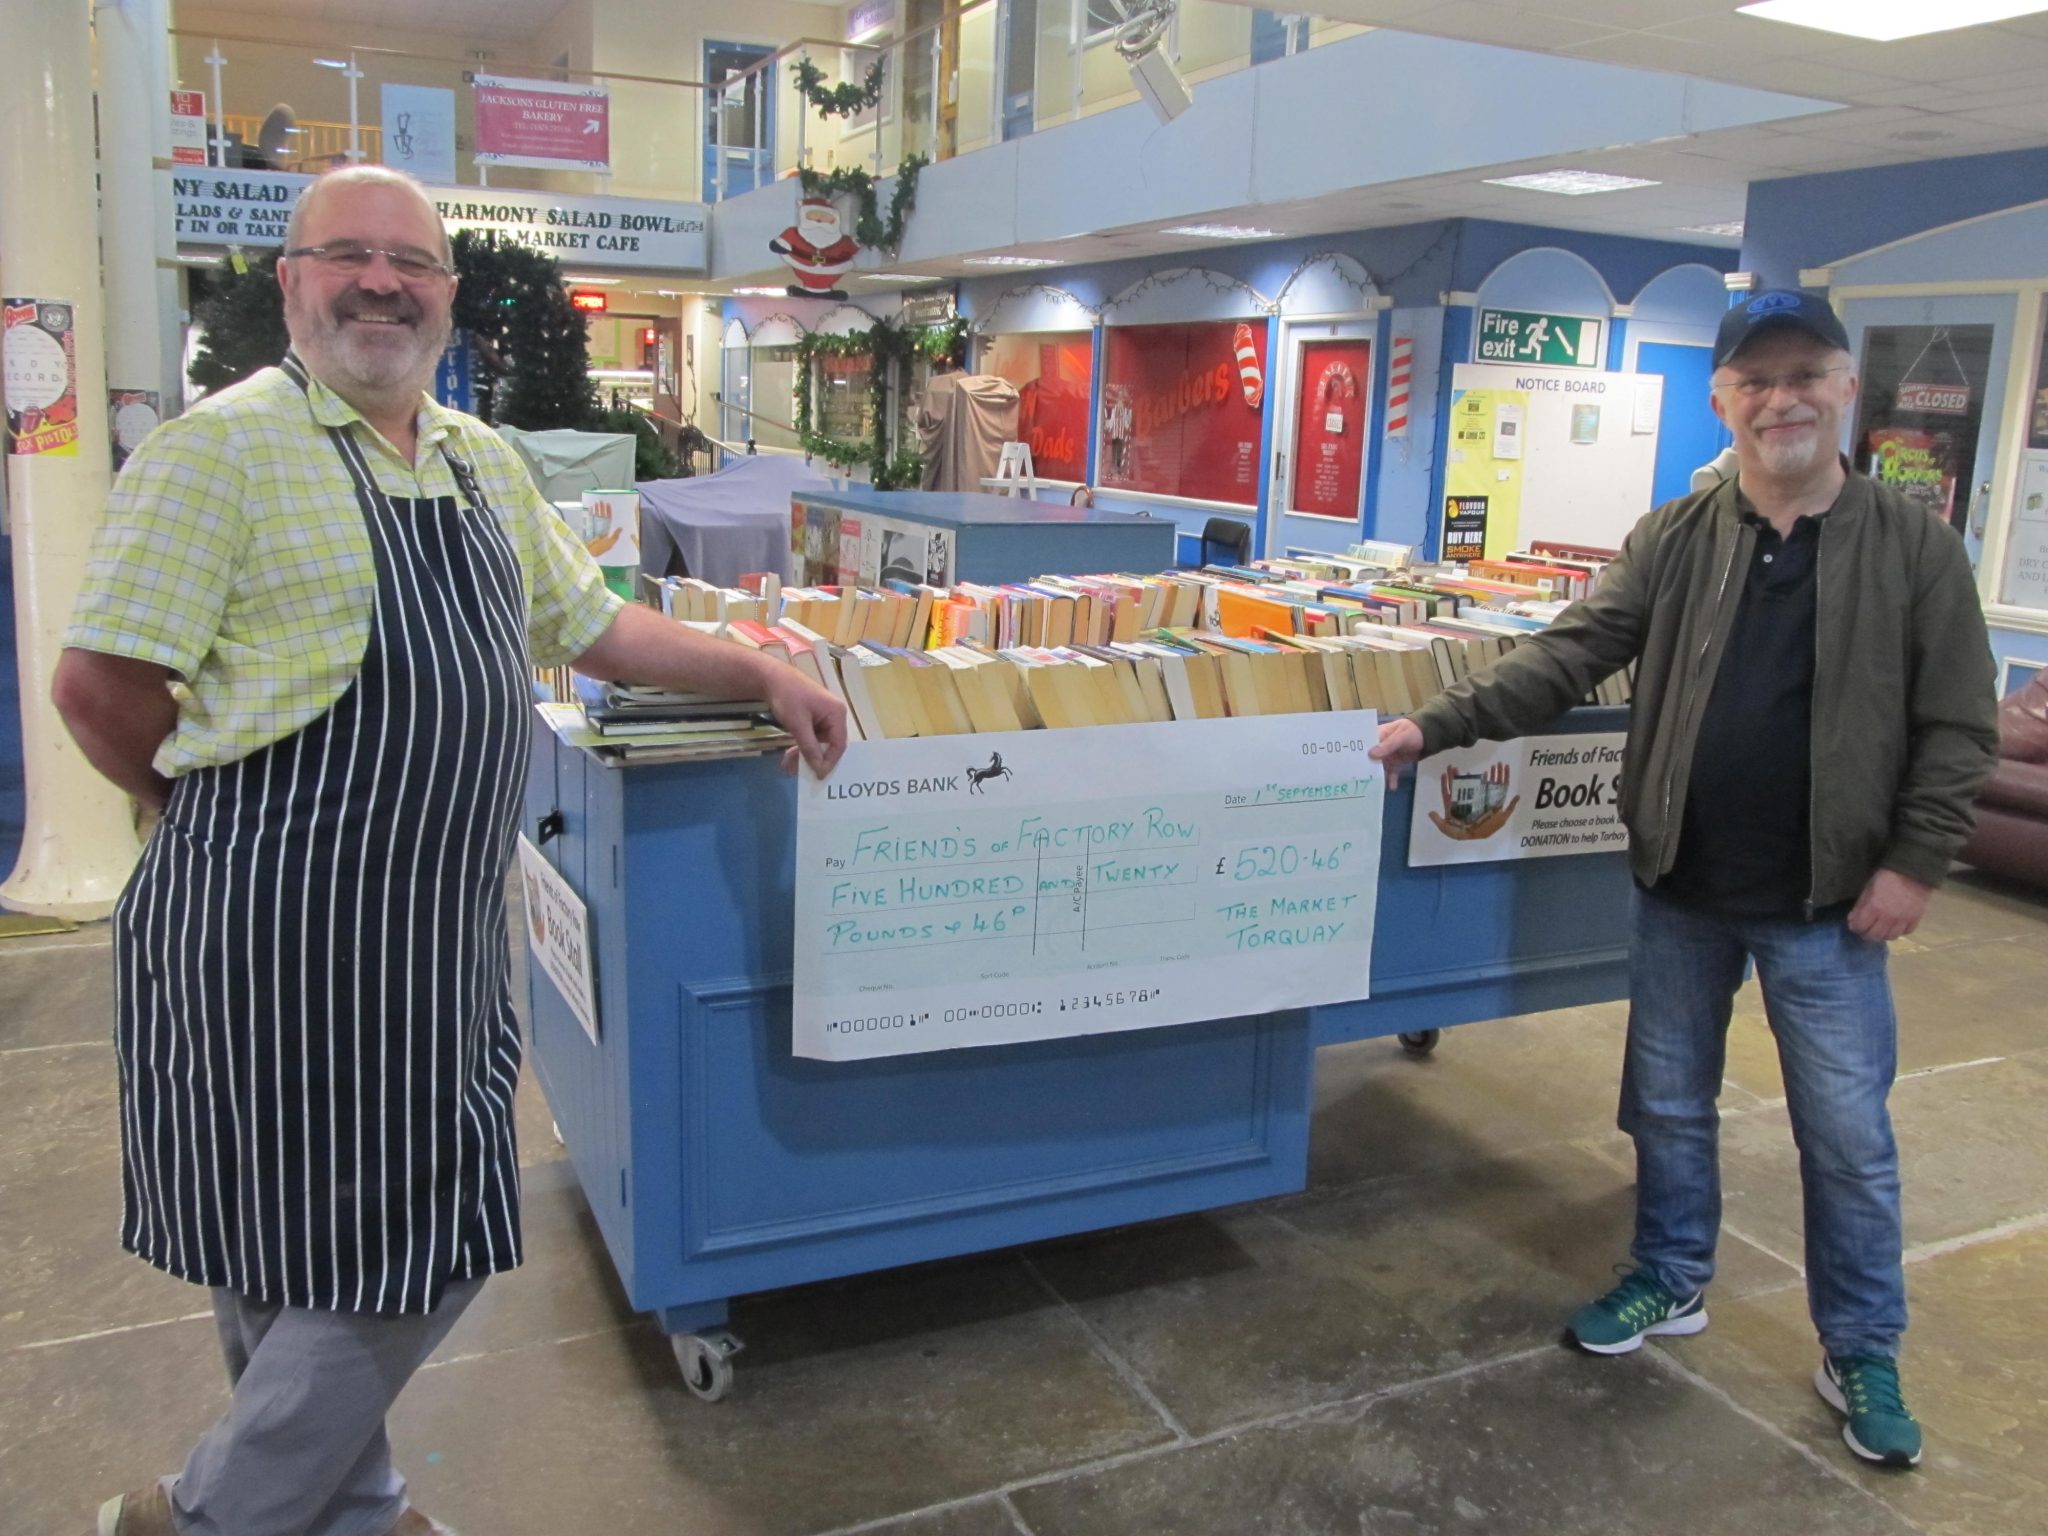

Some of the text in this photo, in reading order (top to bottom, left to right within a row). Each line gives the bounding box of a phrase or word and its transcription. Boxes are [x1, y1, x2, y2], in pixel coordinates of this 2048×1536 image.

[480, 94, 604, 114] JACKSONS GLUTEN FREE
[522, 111, 564, 122] BAKERY
[174, 178, 288, 202] NY SALAD
[229, 206, 242, 219] &
[436, 202, 676, 233] HARMONY SALAD BOWL
[191, 220, 209, 233] IN
[216, 222, 238, 235] OR
[245, 224, 287, 238] TAKE
[517, 230, 590, 249] MARKET
[596, 235, 640, 252] CAFE
[1484, 313, 1518, 336] Fire
[1482, 339, 1516, 358] exit
[1516, 378, 1606, 394] NOTICE BOARD
[1135, 363, 1229, 438] Barbers
[1916, 392, 1966, 409] CLOSED
[1448, 532, 1483, 544] BUY HERE
[1447, 545, 1482, 553] SMOKE
[2019, 557, 2040, 569] DRY
[2018, 571, 2040, 582] AND
[1302, 740, 1364, 755] 00-00-00
[1530, 748, 1579, 767] Friends
[1582, 746, 1598, 764] of
[828, 776, 959, 800] LLOYDS BANK
[1225, 795, 1246, 805] Date
[1277, 783, 1349, 802] SEPTEMBER
[1535, 774, 1606, 810] Book
[1532, 818, 1558, 830] Please
[1560, 818, 1587, 828] choose
[1596, 815, 1615, 824] book
[826, 858, 846, 870] Pay
[992, 841, 1009, 853] OF
[1016, 816, 1134, 850] FACTORY
[1142, 807, 1194, 838] ROW
[1520, 834, 1570, 848] DONATION
[1572, 834, 1580, 844] to
[1581, 832, 1598, 844] help
[832, 860, 1180, 908] FIVE HUNDRED AND TWENTY
[1074, 866, 1084, 893] Payee
[1216, 894, 1358, 920] THE MARKET
[547, 904, 566, 955] Book
[826, 920, 932, 946] POUNDS
[1226, 922, 1344, 950] TORQUAY
